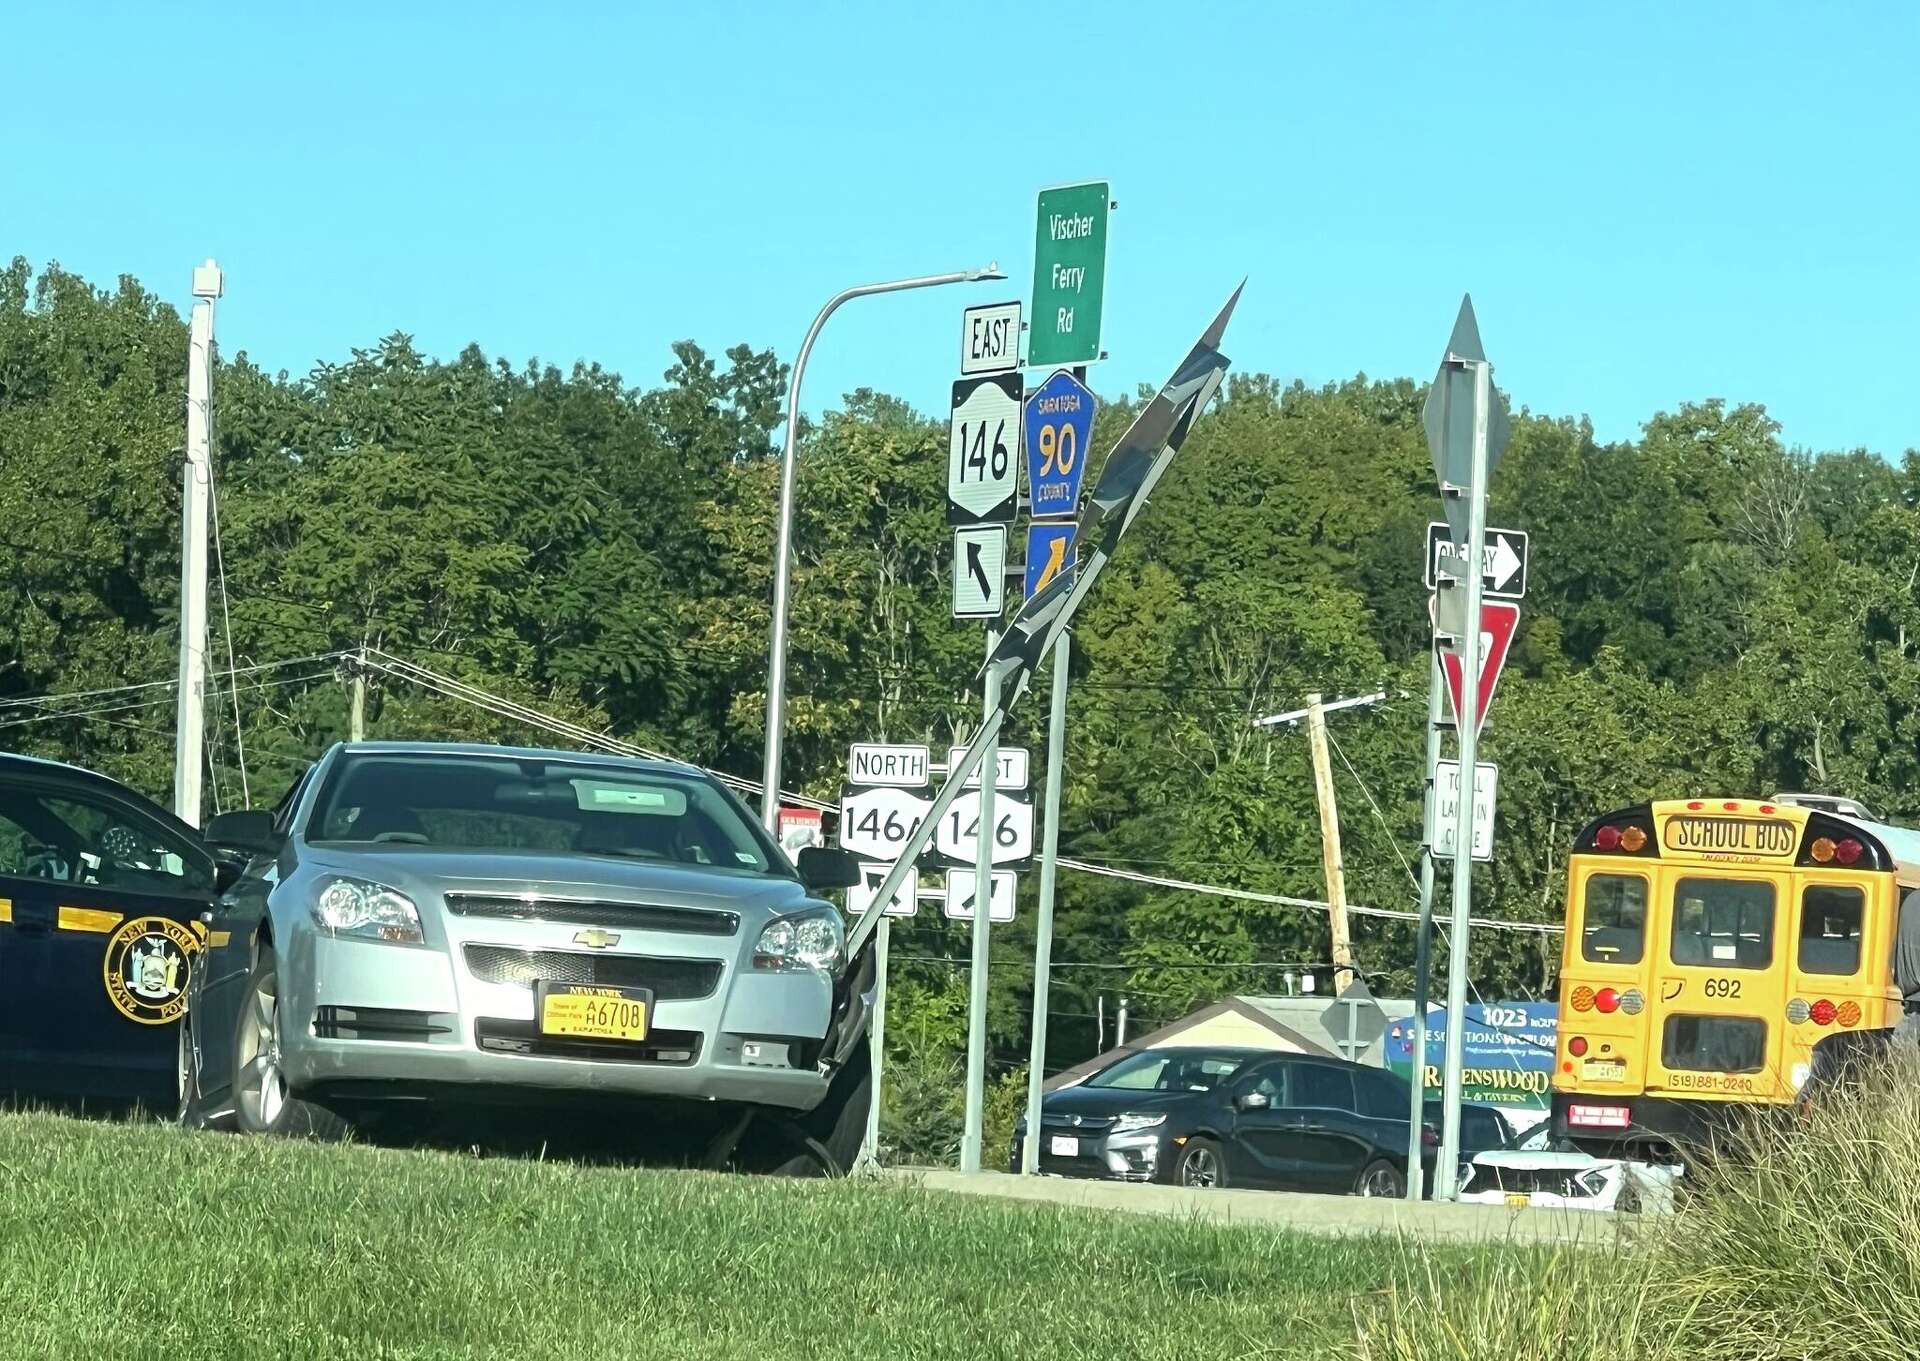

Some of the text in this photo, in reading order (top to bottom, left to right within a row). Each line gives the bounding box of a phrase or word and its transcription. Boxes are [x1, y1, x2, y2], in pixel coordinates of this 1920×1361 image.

[1049, 211, 1094, 241] Vischer
[1052, 263, 1085, 294] Ferry
[1057, 307, 1074, 334] Rd
[970, 317, 1011, 360] EAST
[1038, 394, 1081, 415] SARATOGA
[959, 417, 1009, 485] 146
[1039, 422, 1076, 477] 90
[1037, 481, 1071, 502] COUNTY
[855, 751, 924, 777] NORTH
[1678, 820, 1791, 851] SCHOOL BUS
[119, 921, 196, 955] NEW YORK
[108, 972, 138, 1013] STATE
[569, 986, 623, 999] NEW YORK
[1704, 978, 1741, 999] 692
[598, 1001, 640, 1028] 6708
[1482, 1007, 1528, 1027] 1023
[1424, 1065, 1549, 1093] RENSWOOD
[1483, 1092, 1527, 1102] TAVERN
